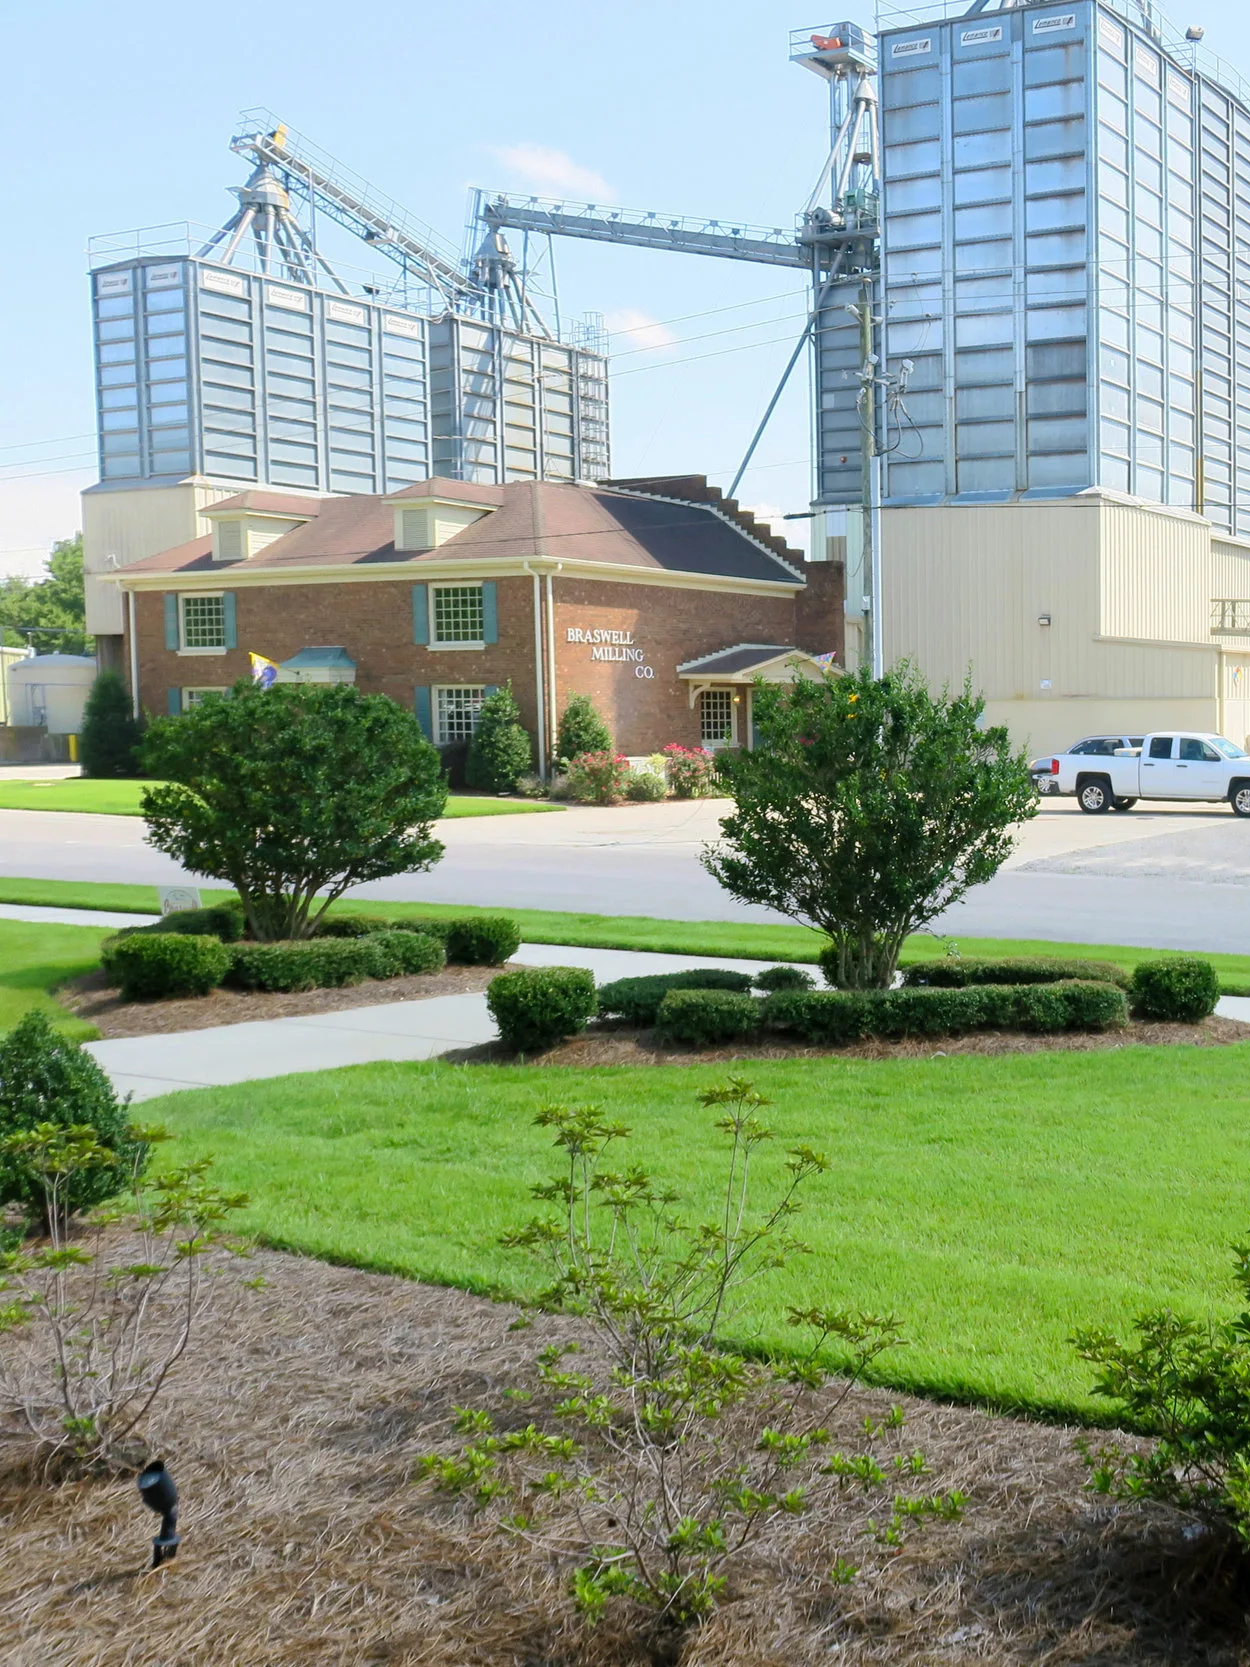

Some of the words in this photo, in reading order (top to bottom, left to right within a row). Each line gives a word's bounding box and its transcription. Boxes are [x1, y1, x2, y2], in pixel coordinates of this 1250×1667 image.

[567, 628, 634, 645] BRASWELL
[591, 646, 644, 662] MILLING
[635, 665, 655, 679] CO.
